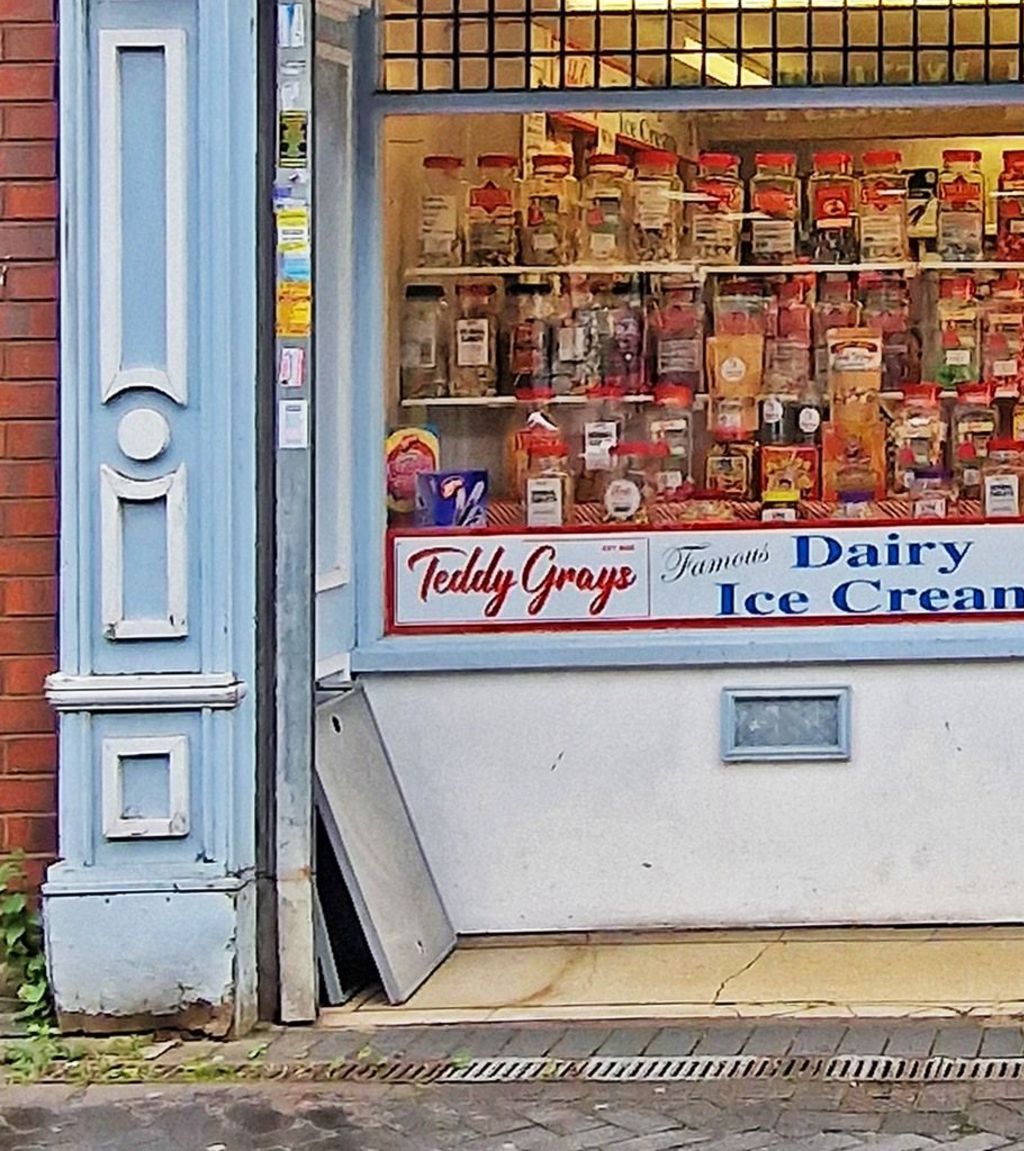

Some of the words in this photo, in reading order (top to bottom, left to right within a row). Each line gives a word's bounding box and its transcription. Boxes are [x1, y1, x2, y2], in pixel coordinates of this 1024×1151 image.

[407, 544, 518, 617] Teddy
[522, 545, 637, 616] Grays
[661, 542, 770, 583] Famous
[790, 533, 975, 574] Dairy
[715, 582, 809, 616] Ice
